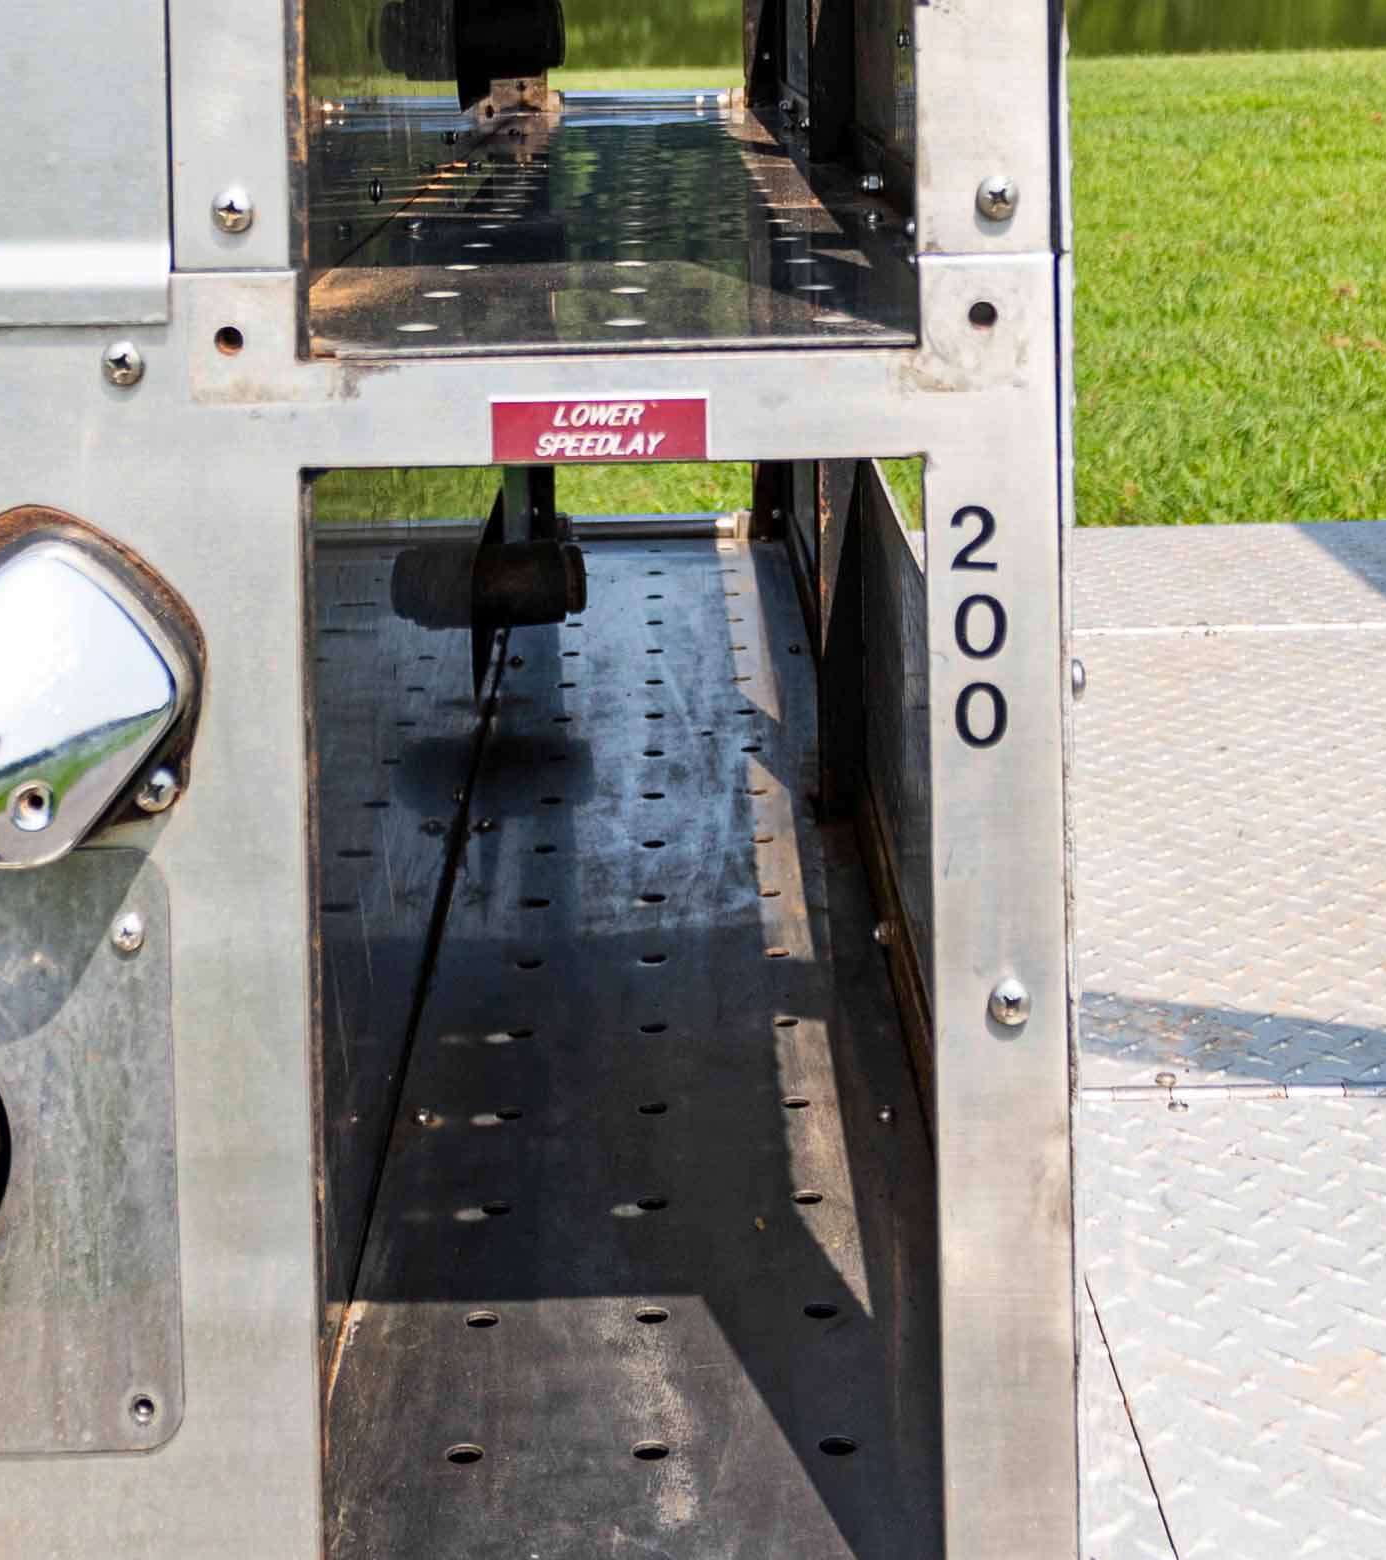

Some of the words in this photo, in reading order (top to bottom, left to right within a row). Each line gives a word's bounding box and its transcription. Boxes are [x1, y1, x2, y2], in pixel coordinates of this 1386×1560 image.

[552, 402, 646, 428] LOWER
[534, 431, 667, 457] SPEEDLAY
[950, 504, 1009, 749] 200
